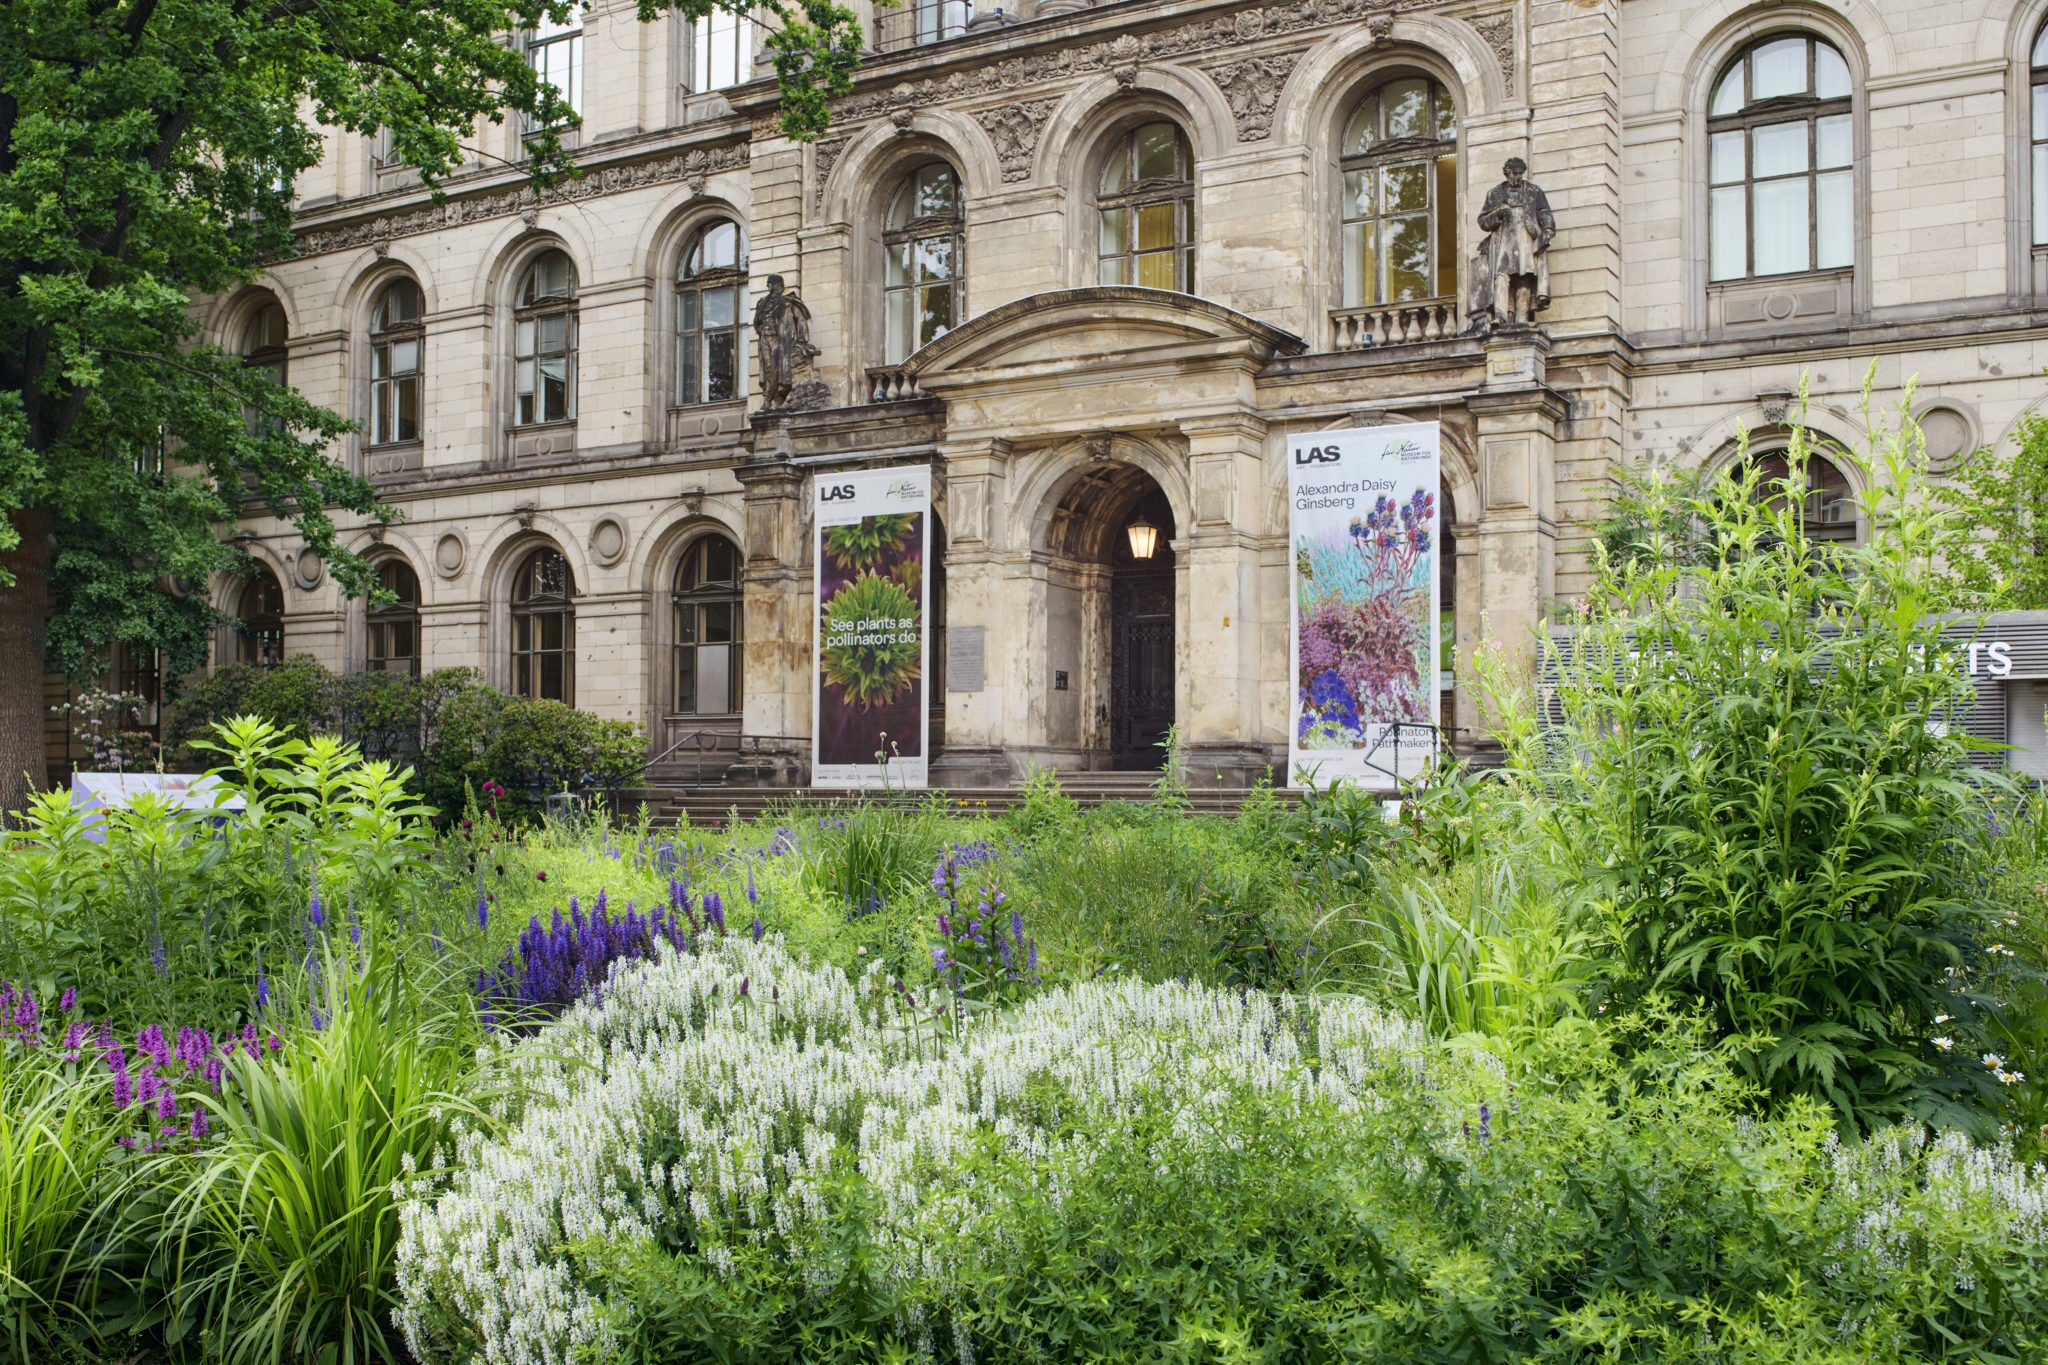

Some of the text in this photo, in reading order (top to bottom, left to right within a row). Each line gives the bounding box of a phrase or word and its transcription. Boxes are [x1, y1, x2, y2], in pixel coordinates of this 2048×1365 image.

[1295, 445, 1341, 465] LAS
[820, 484, 856, 502] LAS
[1296, 478, 1397, 497] Alexandra Daisy
[1296, 496, 1355, 511] Ginsberg
[830, 616, 913, 634] See plants as
[826, 629, 917, 650] pollinators do
